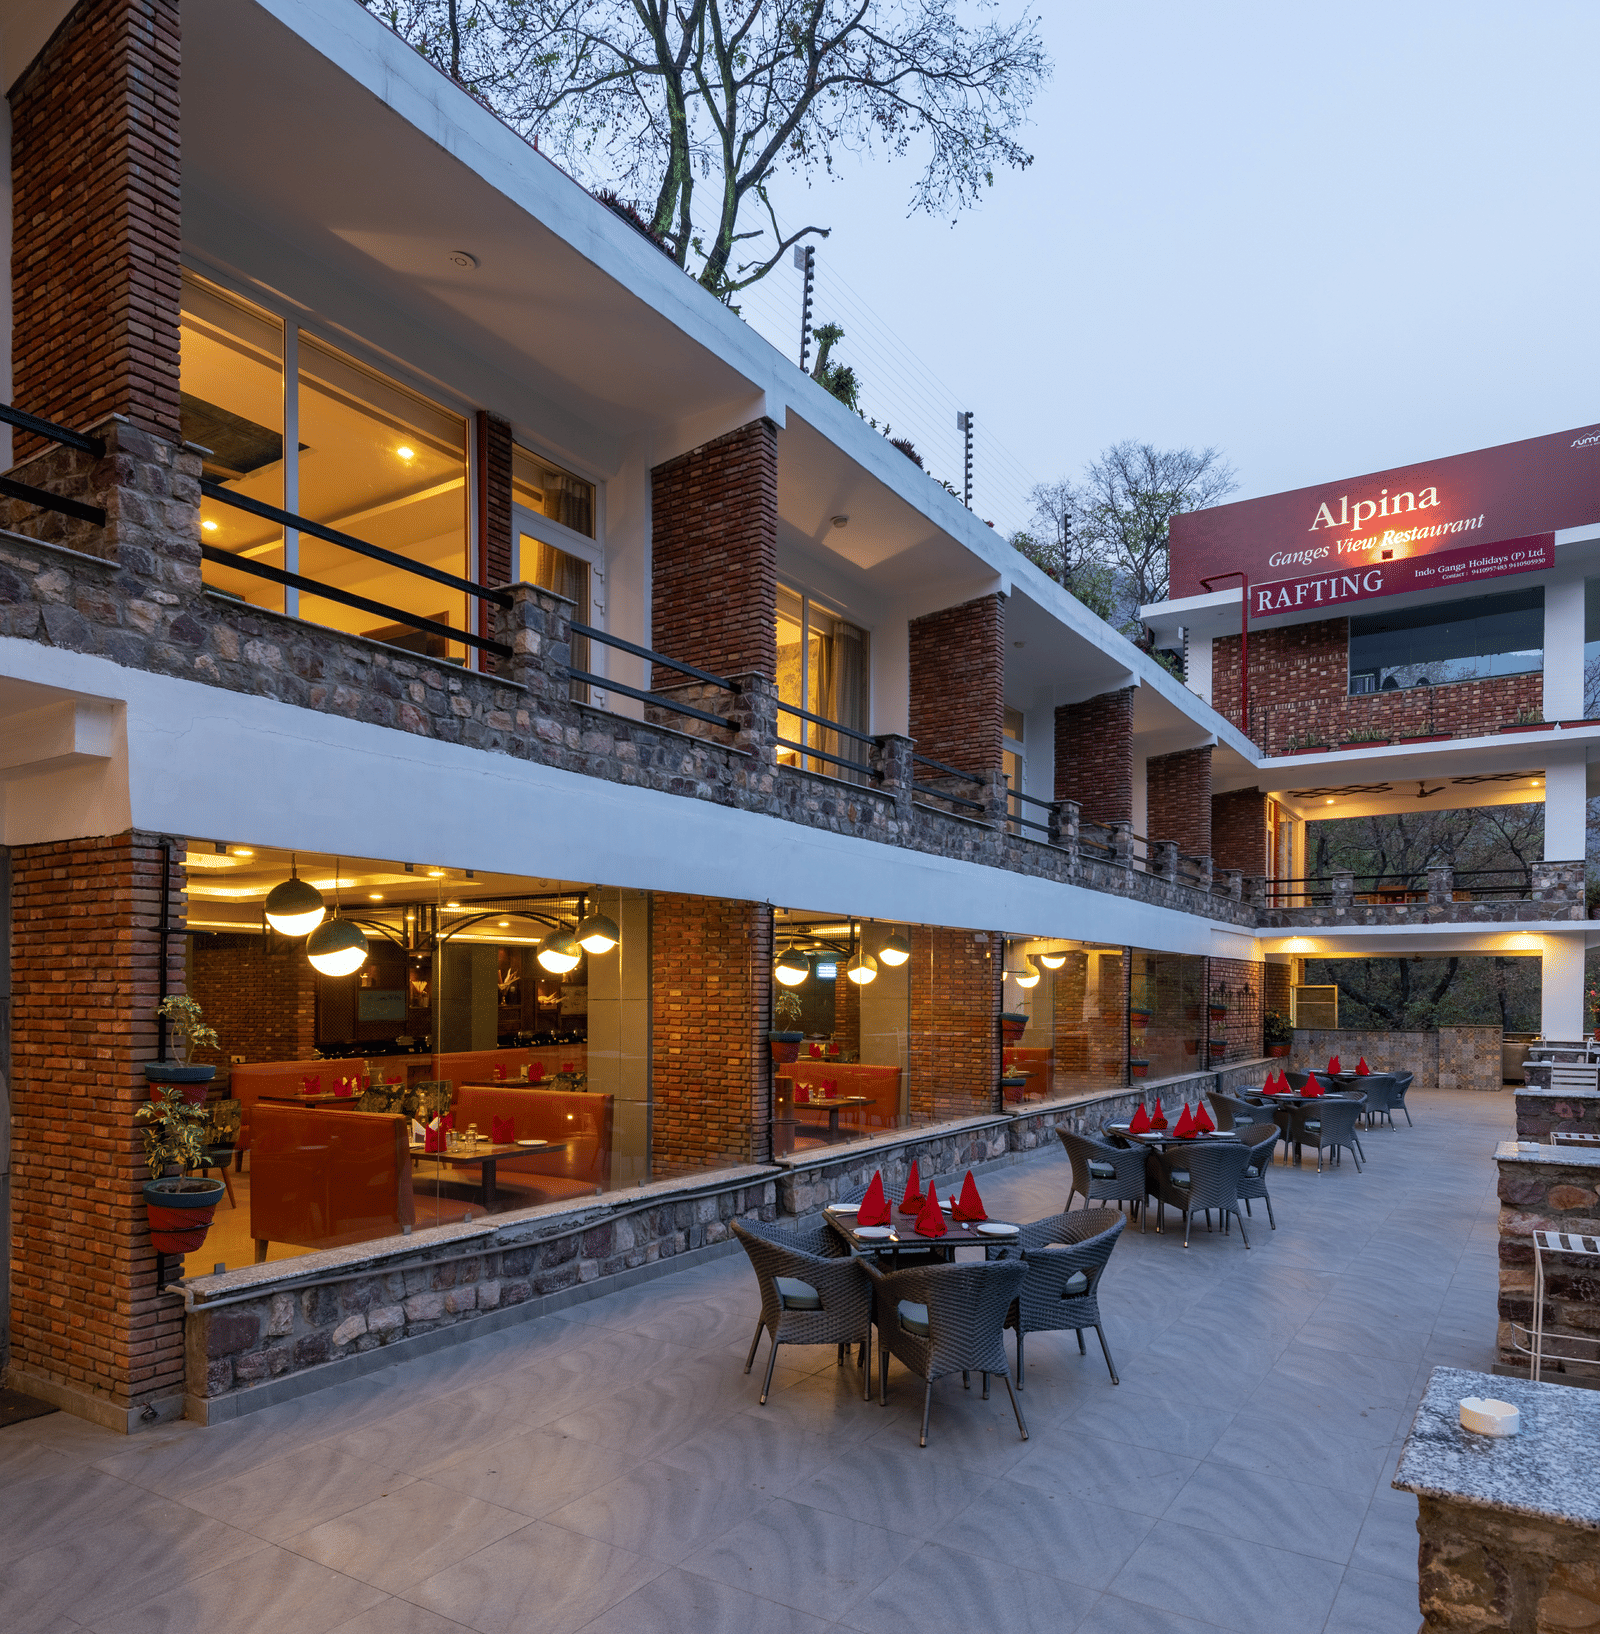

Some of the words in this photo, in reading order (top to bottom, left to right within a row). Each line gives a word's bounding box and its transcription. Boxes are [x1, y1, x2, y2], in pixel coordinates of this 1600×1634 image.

[1308, 486, 1441, 531] Alpina
[1268, 546, 1330, 567] Ganges
[1335, 536, 1377, 555] View
[1380, 513, 1485, 547] Restaurant
[1415, 567, 1436, 577] Indo
[1437, 563, 1466, 573] Ganga
[1469, 555, 1509, 568] Holidays
[1511, 551, 1526, 561] (P)
[1528, 548, 1546, 558] Ltd.
[1442, 572, 1465, 580] Contact
[1257, 570, 1384, 612] RAFTING
